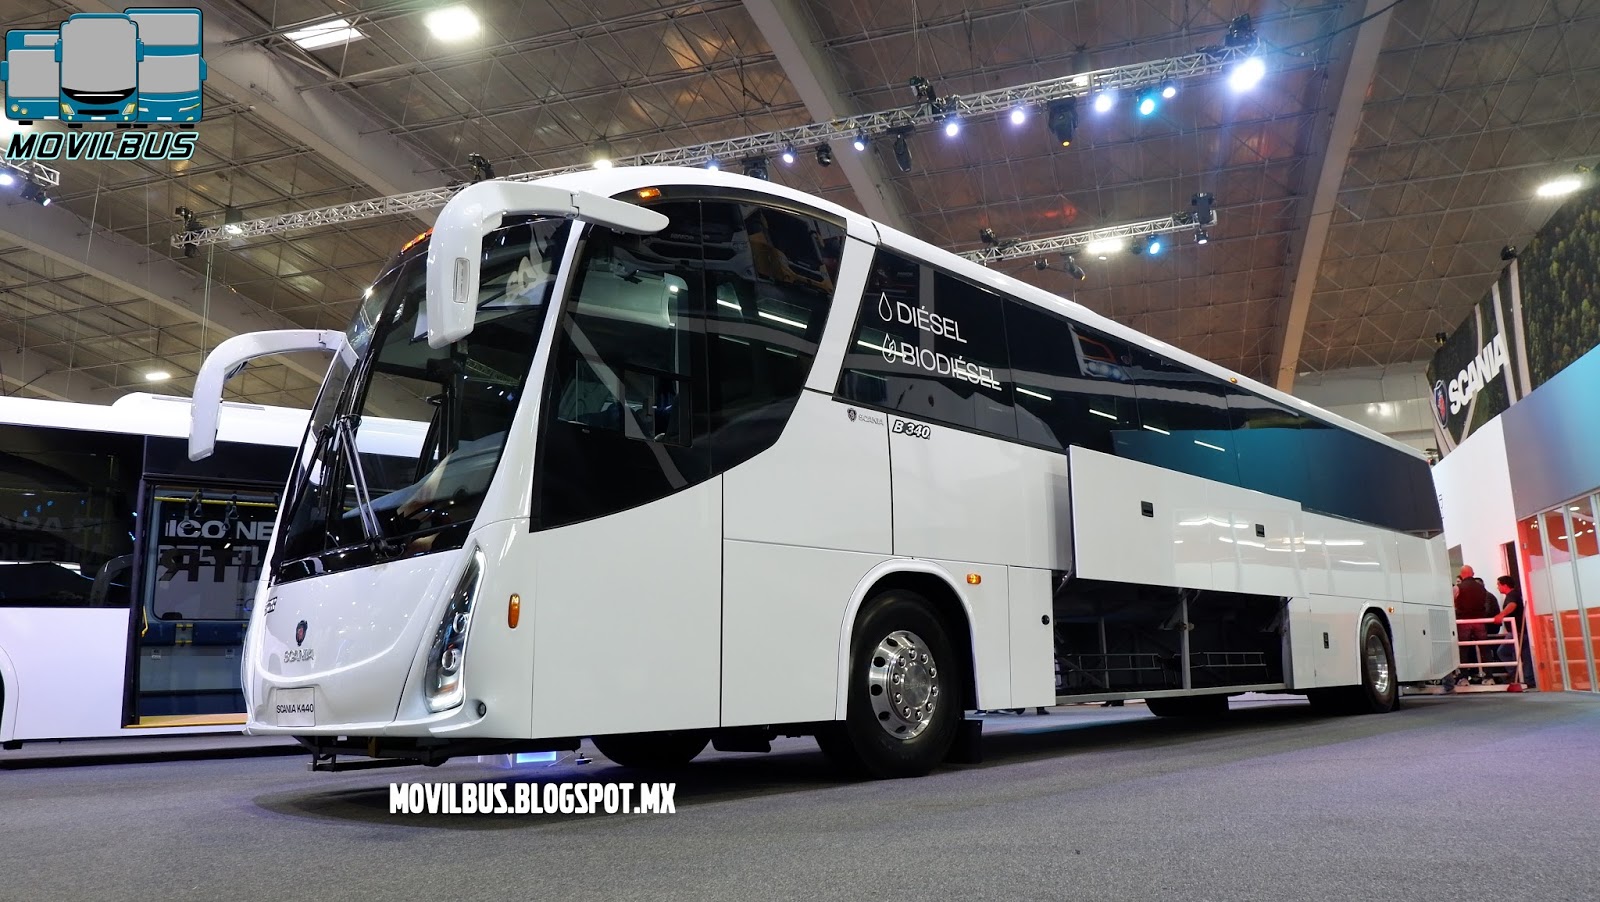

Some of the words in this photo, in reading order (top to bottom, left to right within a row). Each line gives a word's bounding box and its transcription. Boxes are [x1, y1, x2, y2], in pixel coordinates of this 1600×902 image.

[896, 301, 967, 343] DIÉSEL
[901, 342, 1002, 391] BIODIÉSEL
[1449, 333, 1510, 415] SCANIA
[858, 414, 884, 426] SCANIA
[892, 419, 906, 434] B
[905, 422, 931, 440] 340
[284, 648, 314, 663] SCANIA
[276, 704, 297, 714] SCANIA
[297, 703, 314, 713] K440
